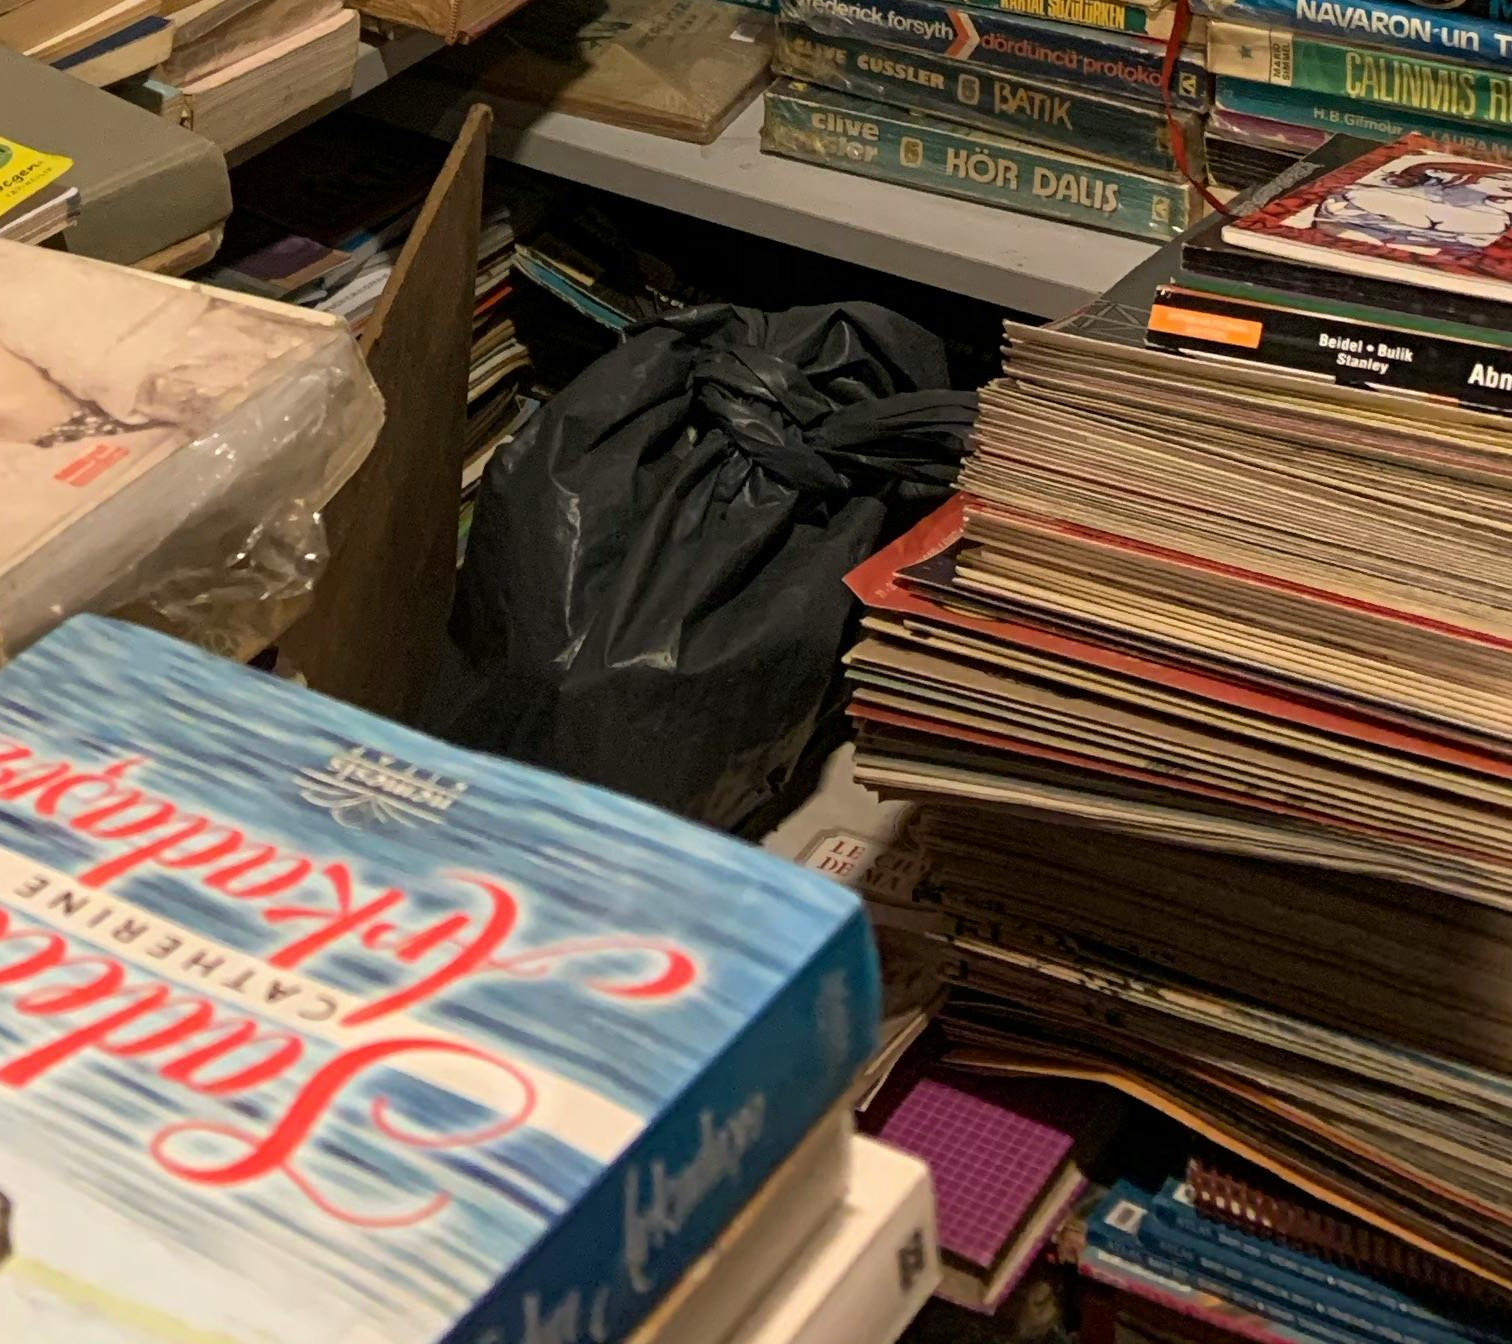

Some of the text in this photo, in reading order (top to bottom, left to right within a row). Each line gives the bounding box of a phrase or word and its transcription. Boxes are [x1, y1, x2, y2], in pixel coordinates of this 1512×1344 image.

[887, 11, 954, 42] forsyth
[980, 33, 1079, 70] dördüncü
[1083, 56, 1163, 88] protoko
[857, 54, 1074, 130] CUSSLER BATIK
[1345, 50, 1478, 119] ÇALINMIŞ
[945, 147, 1119, 214] HÖR DALIŞ
[1319, 334, 1413, 363] Beidel Bulik
[1337, 354, 1389, 375] Stanley
[13, 873, 343, 1025] CATHERINE
